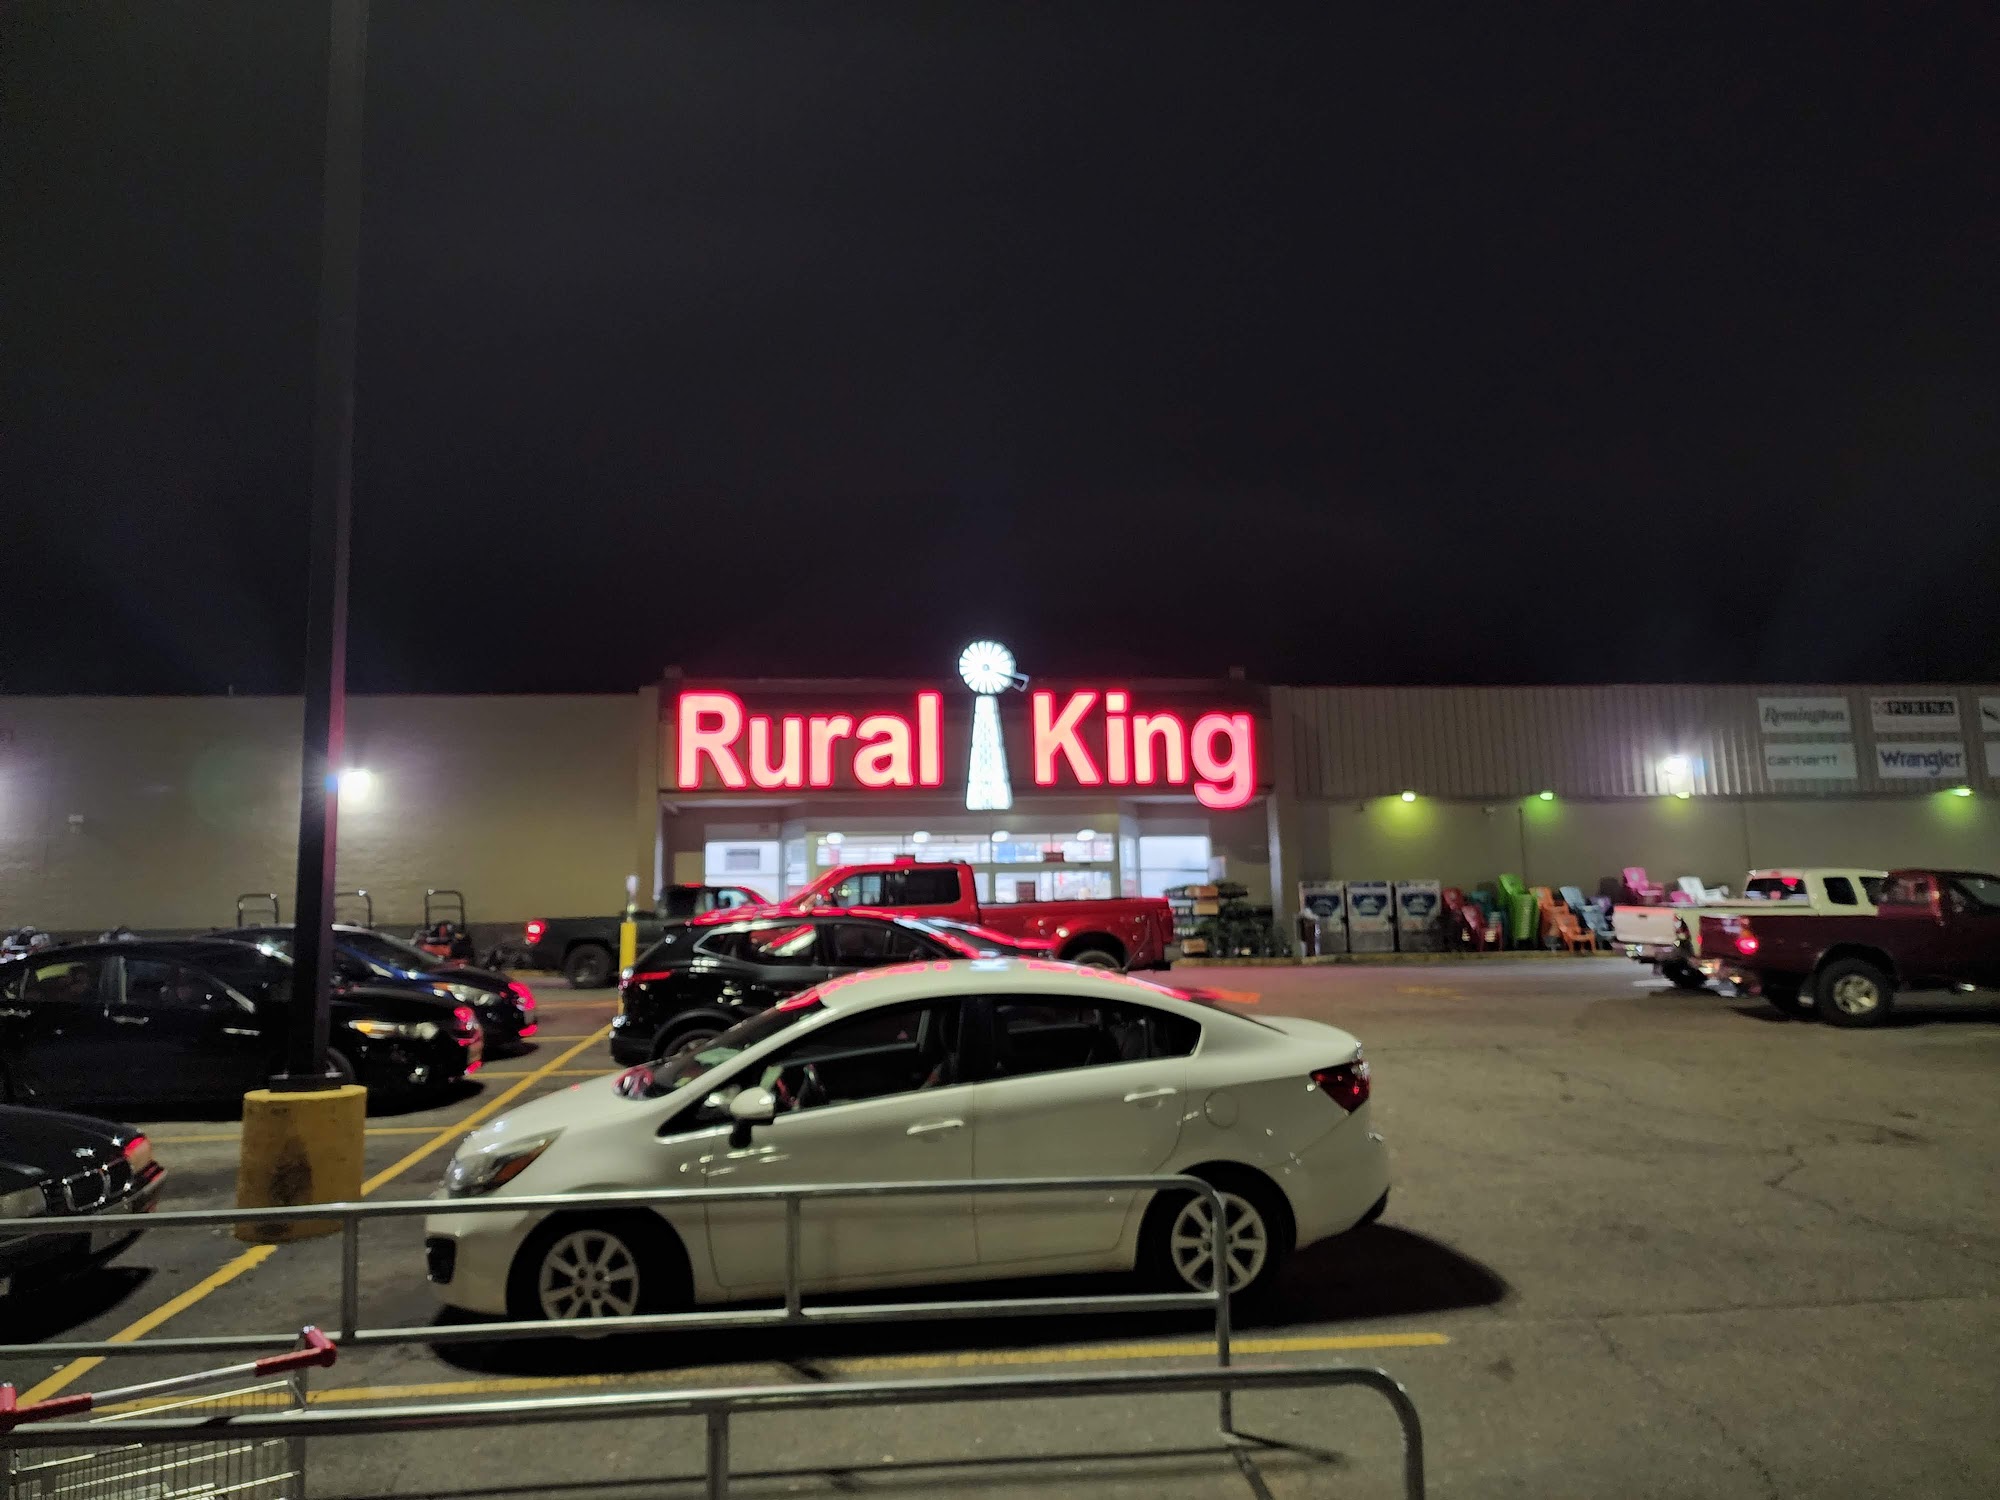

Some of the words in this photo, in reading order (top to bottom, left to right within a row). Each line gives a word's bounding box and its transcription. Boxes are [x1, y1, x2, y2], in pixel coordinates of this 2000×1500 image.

[1764, 706, 1845, 727] Remington
[678, 691, 943, 788] Rural
[1033, 690, 1256, 809] King
[1880, 750, 1961, 776] Wrangler
